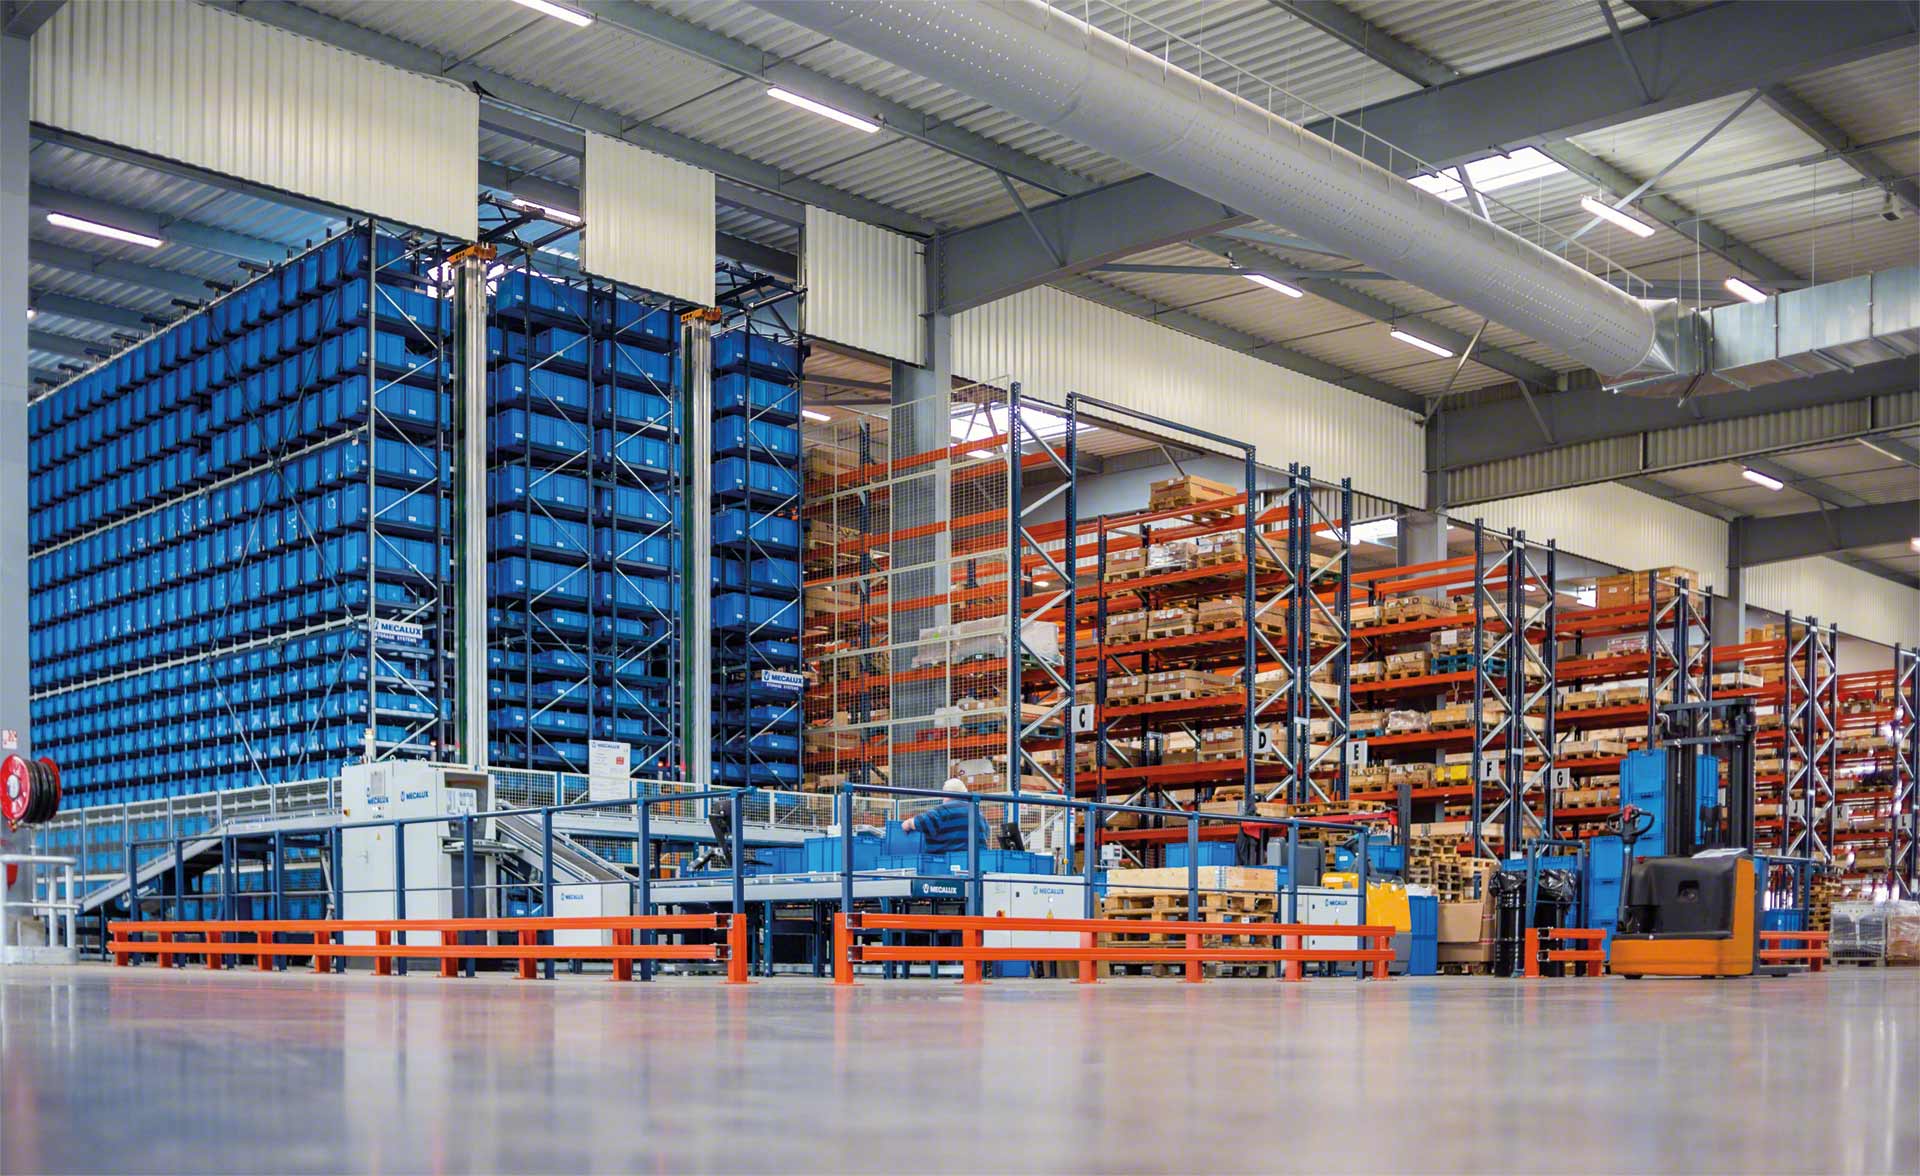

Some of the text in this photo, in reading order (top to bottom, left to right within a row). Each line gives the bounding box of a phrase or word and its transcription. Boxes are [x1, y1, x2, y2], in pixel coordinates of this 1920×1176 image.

[381, 623, 421, 636] MECALUX
[771, 674, 802, 684] MECALUX
[1079, 708, 1086, 728] C
[1258, 732, 1267, 749] D
[1353, 744, 1360, 761] E
[1486, 762, 1492, 777] F
[1556, 771, 1563, 786] G
[367, 796, 389, 805] MECALUX
[406, 791, 429, 800] MECALUX
[1793, 801, 1798, 814] J
[1837, 806, 1843, 818] K
[1901, 815, 1907, 827] L
[930, 886, 957, 894] MECALUX
